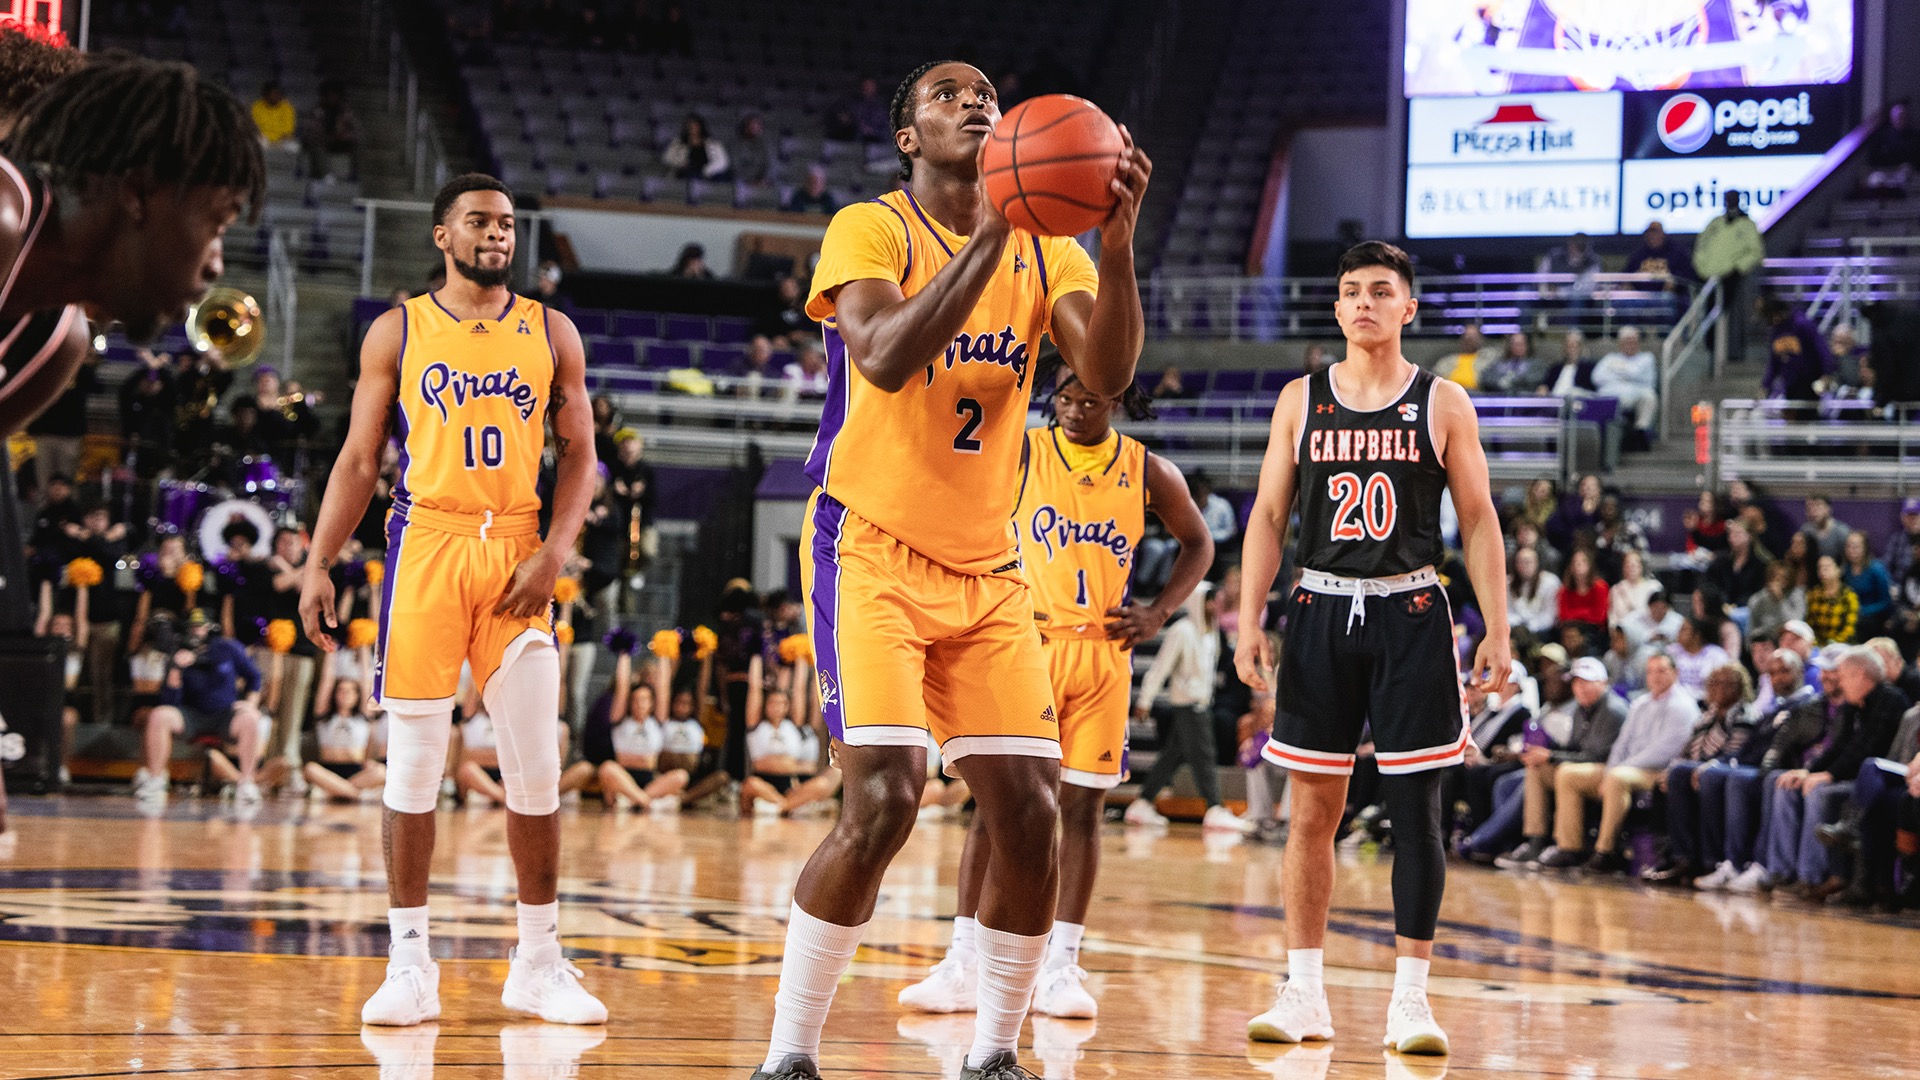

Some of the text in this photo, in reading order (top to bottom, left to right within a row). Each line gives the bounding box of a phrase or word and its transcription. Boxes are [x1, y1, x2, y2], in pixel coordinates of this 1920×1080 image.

[1714, 91, 1811, 135] pepsi
[1453, 127, 1574, 154] Pizza Hut
[1504, 185, 1613, 211] HEALTH
[1647, 179, 1788, 213] optiu
[419, 361, 538, 426] Pirates
[463, 425, 505, 470] 10
[953, 397, 984, 455] 2
[1309, 428, 1421, 463] CAMPBELL
[1327, 471, 1398, 542] 20
[1031, 504, 1132, 569] Pirates
[1075, 568, 1089, 608] 1
